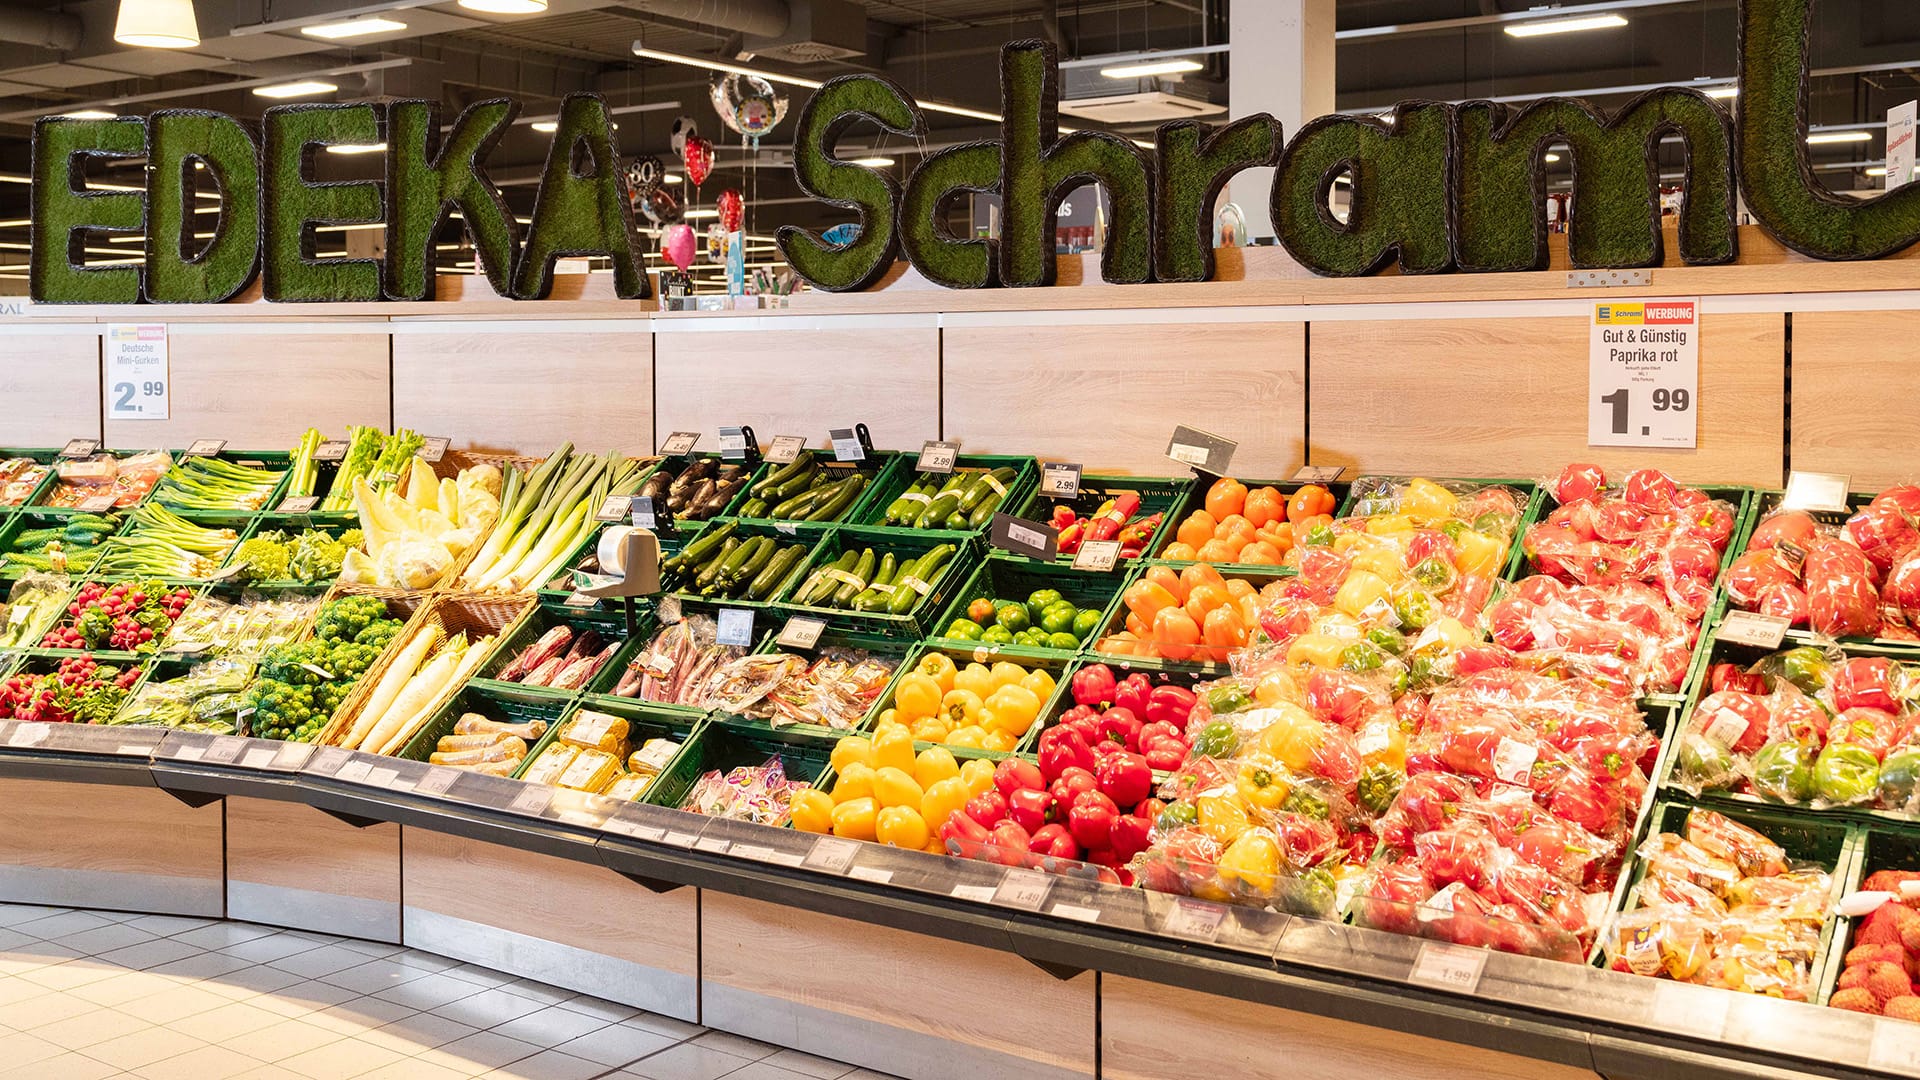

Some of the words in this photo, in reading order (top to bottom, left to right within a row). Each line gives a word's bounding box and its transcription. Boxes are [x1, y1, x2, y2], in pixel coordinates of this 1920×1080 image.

[29, 90, 652, 305] EDEKA
[777, 0, 1920, 292] Schraml
[631, 161, 654, 184] 80
[1646, 308, 1692, 320] WERBUNG
[1603, 330, 1624, 343] Gut
[1627, 330, 1636, 343] &
[1640, 329, 1687, 345] Günstig
[121, 343, 154, 353] Deutsche
[117, 355, 160, 365] Mini-Gurken
[1610, 348, 1657, 364] Paprika
[1660, 348, 1678, 362] rot
[933, 456, 950, 466] 2.99
[1056, 480, 1074, 490] 2.99
[1092, 555, 1111, 564] 1.49
[796, 631, 814, 641] 0.99
[1746, 628, 1776, 640] 3.99
[1016, 890, 1040, 902] 1.49
[1442, 967, 1472, 982] 1.99
